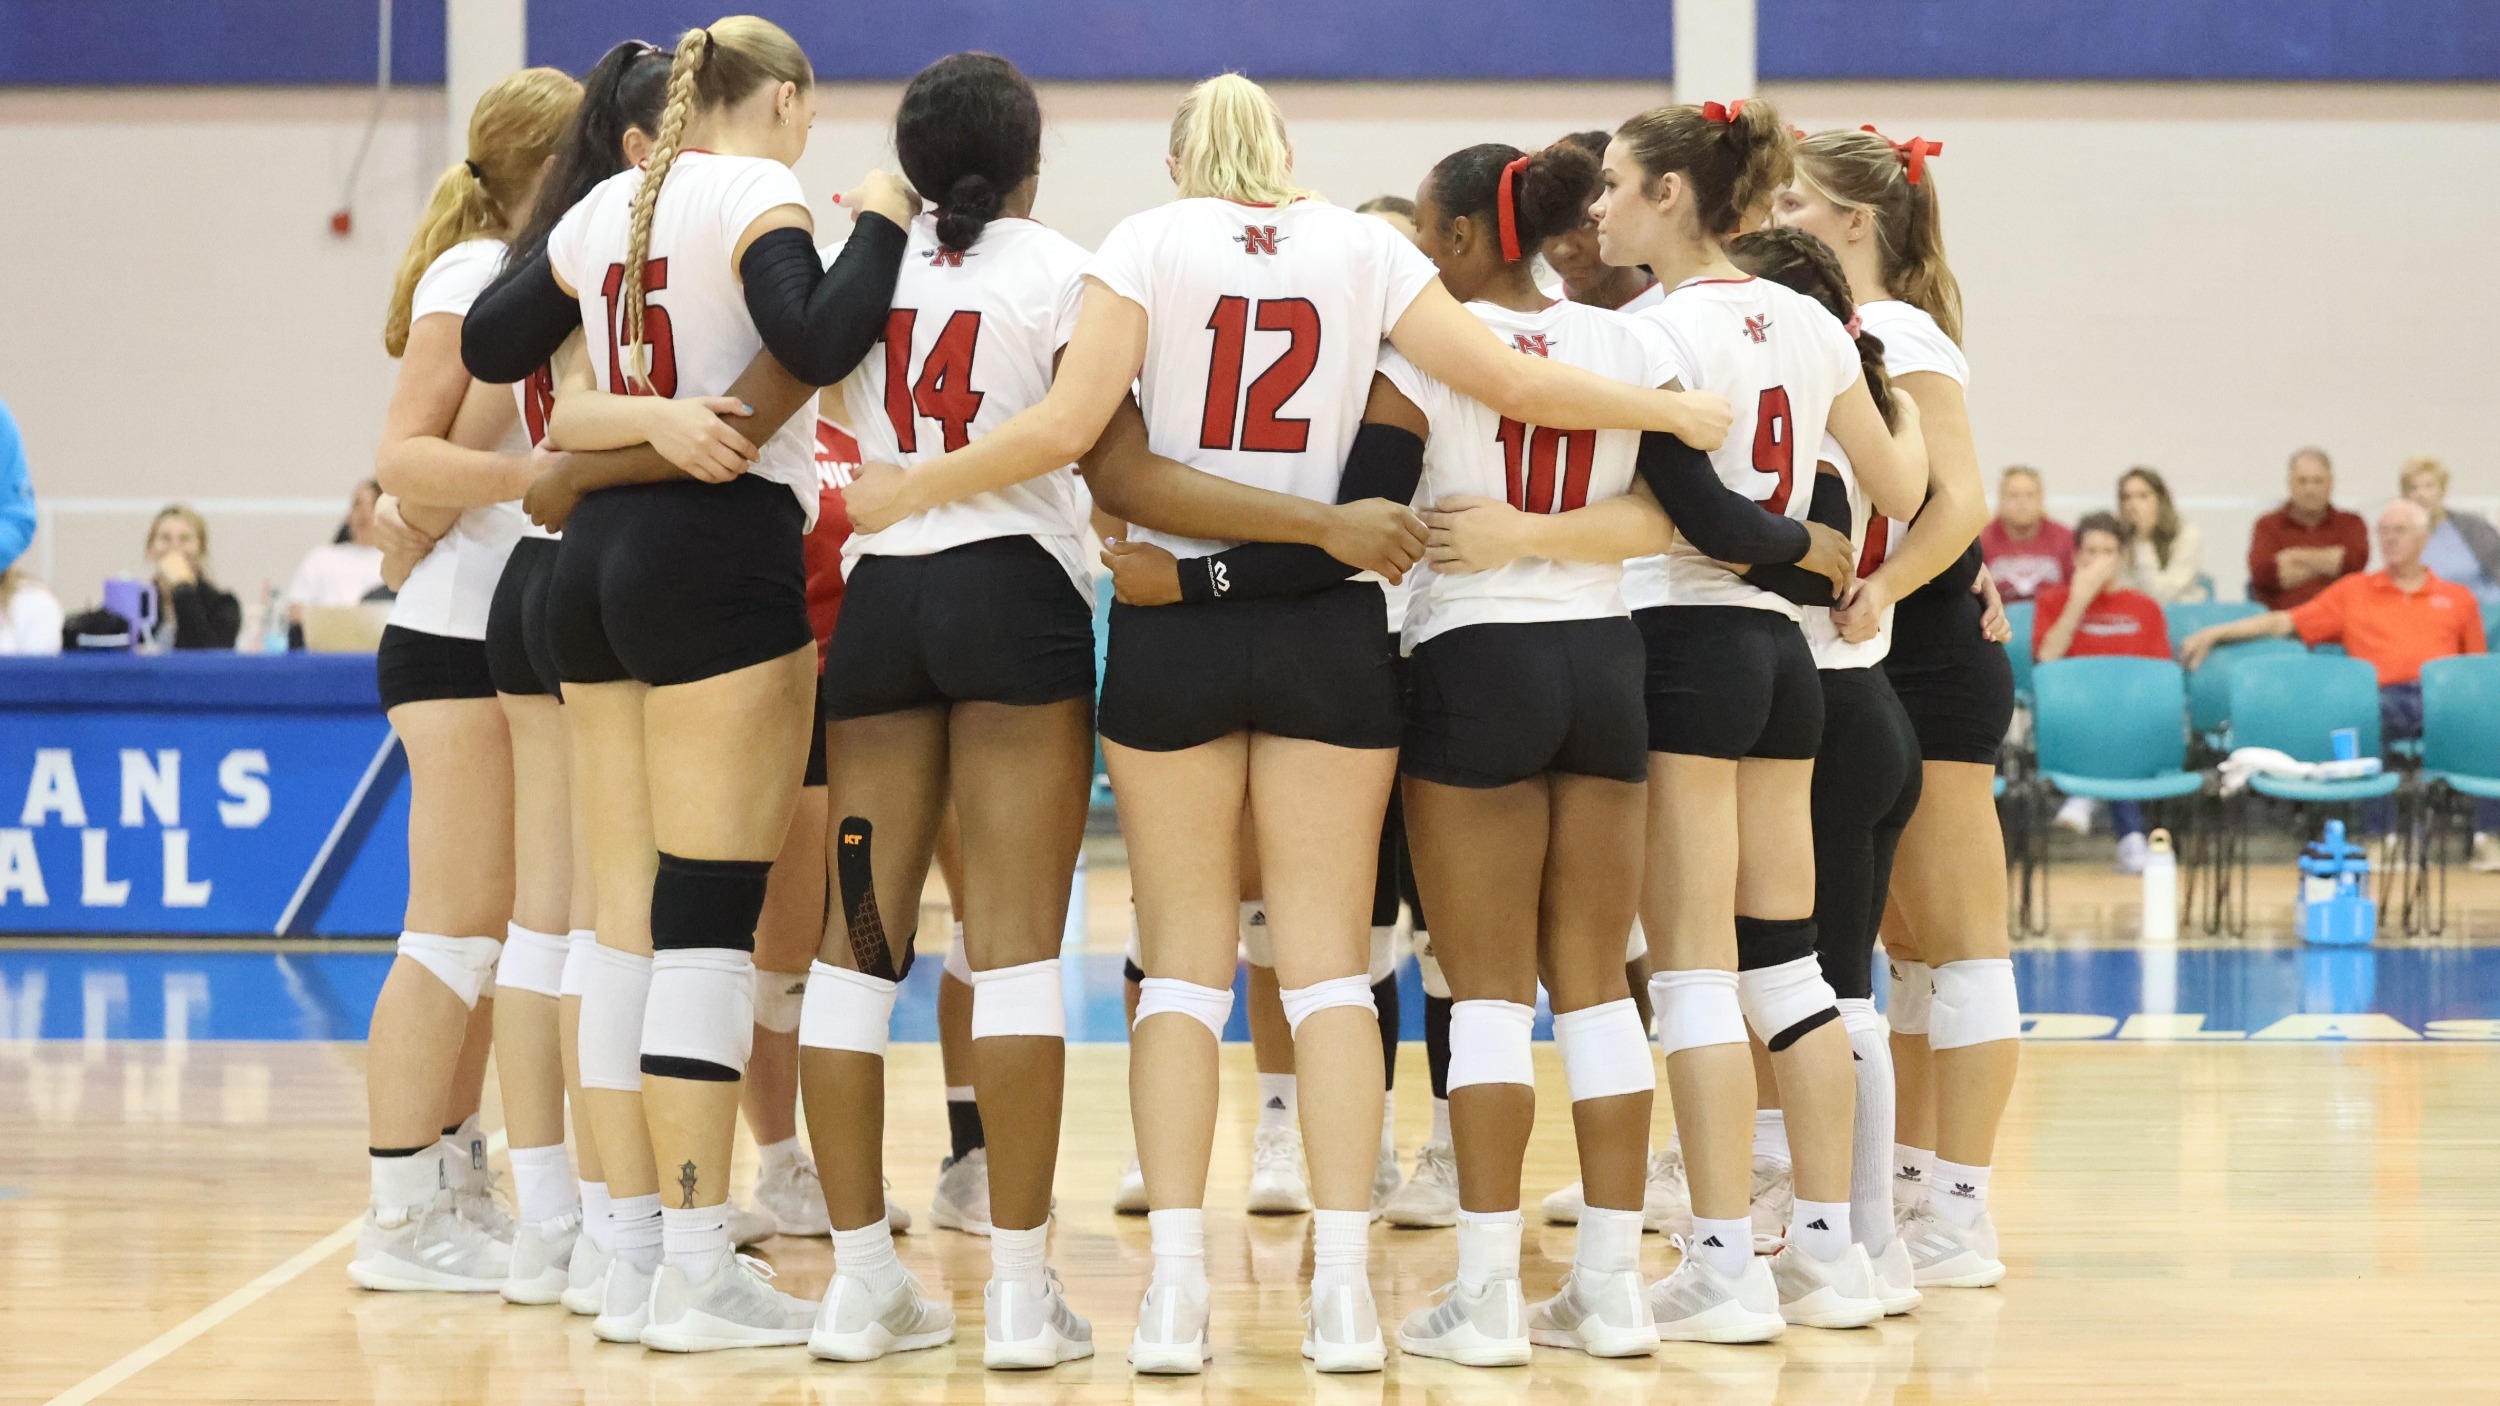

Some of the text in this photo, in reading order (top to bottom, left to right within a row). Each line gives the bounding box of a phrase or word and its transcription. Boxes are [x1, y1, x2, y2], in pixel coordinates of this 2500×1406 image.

[601, 256, 677, 399] 15
[877, 308, 985, 453] 14
[1199, 294, 1321, 453] 12
[1495, 414, 1597, 514] 10
[1752, 385, 1793, 515] 9
[19, 747, 272, 829] ANS
[844, 833, 863, 845] KT
[0, 827, 212, 908] ALL
